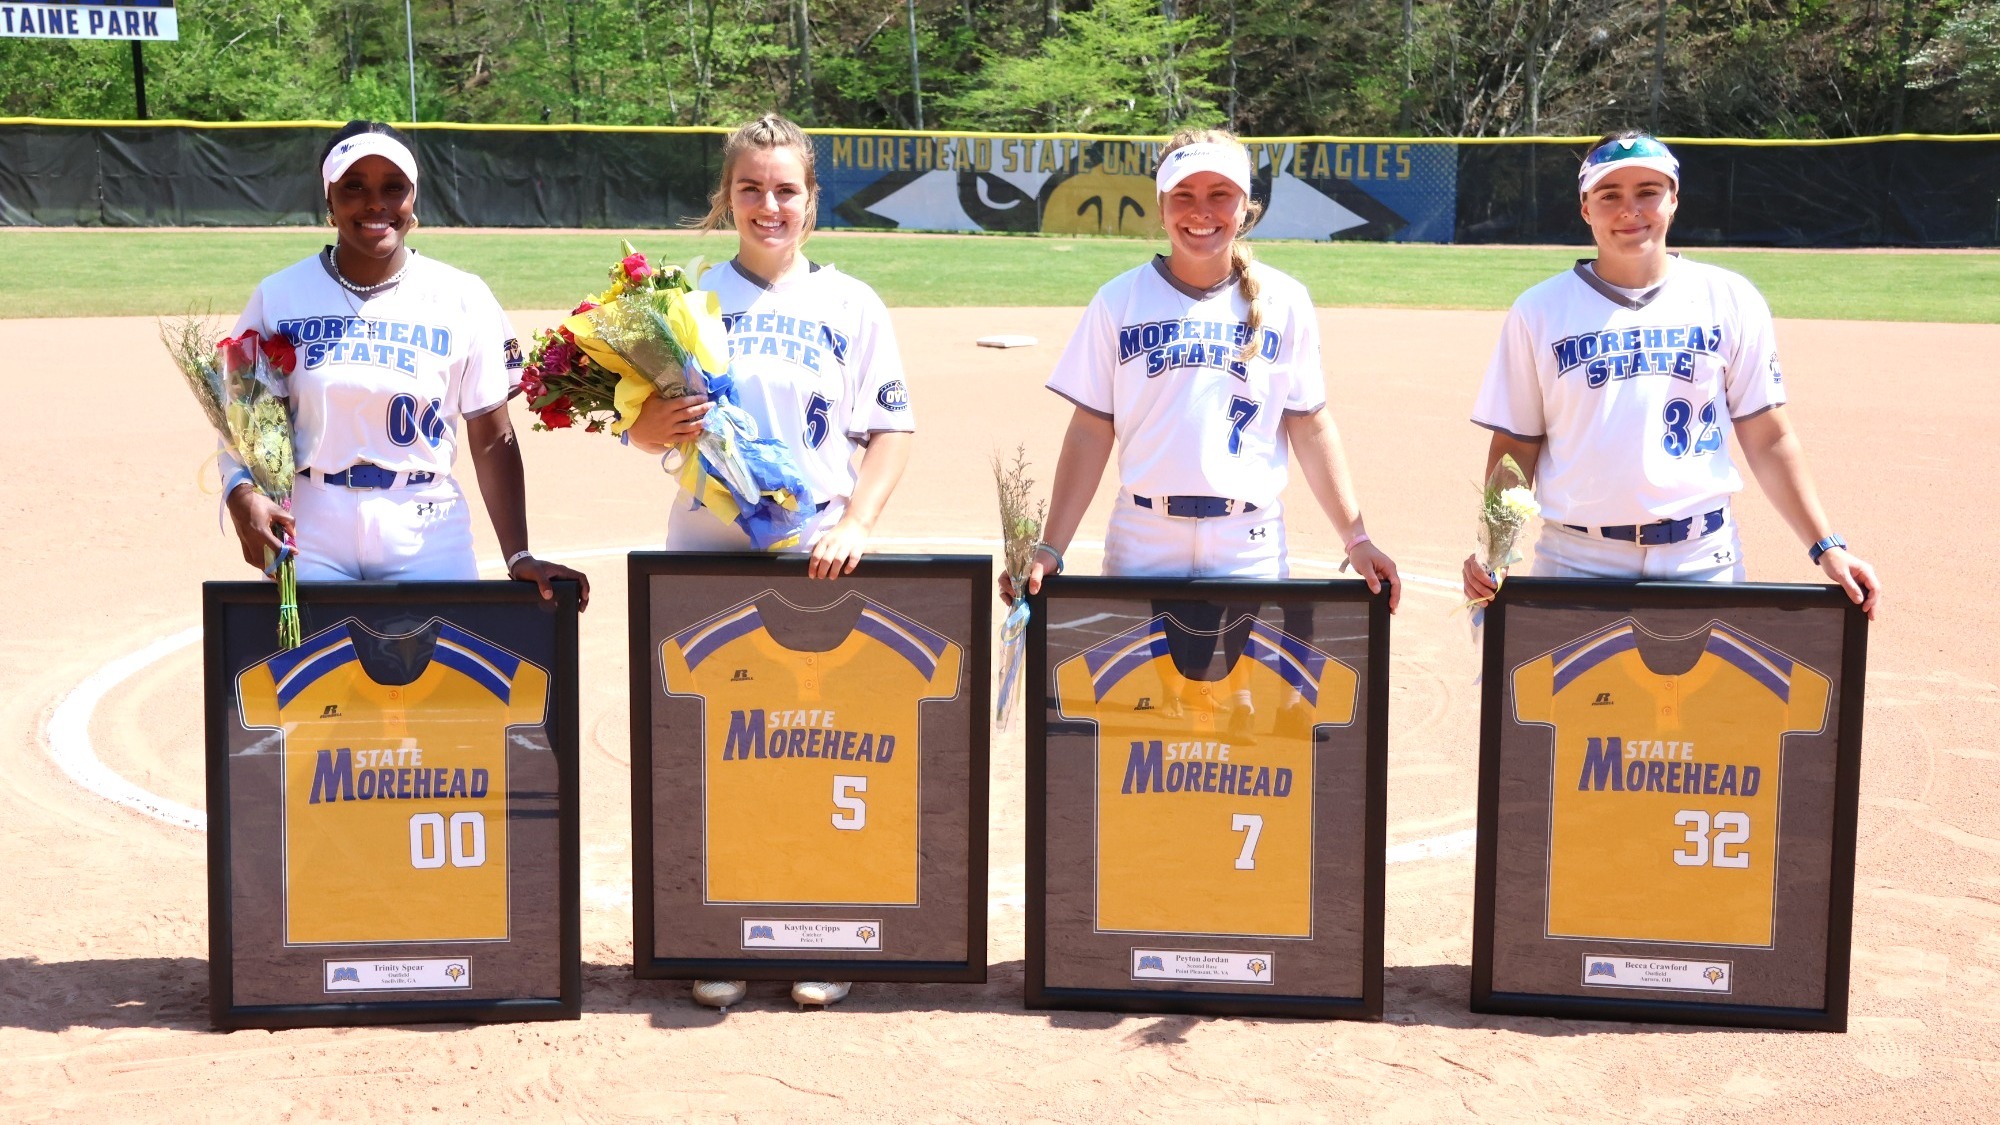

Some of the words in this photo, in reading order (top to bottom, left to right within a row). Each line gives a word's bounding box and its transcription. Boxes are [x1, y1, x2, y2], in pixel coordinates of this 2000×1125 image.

[89, 10, 159, 37] PARK
[832, 136, 992, 172] MOREHEAD
[1002, 138, 1093, 174] STATE
[1102, 140, 1287, 177] UNITY
[1293, 143, 1412, 180] EAGLES
[305, 342, 418, 379] STATE
[1586, 350, 1694, 389] STATE
[803, 391, 835, 451] 5
[1226, 395, 1262, 458] 7
[1661, 397, 1723, 460] 32
[723, 709, 895, 763] MOREHEAD
[768, 709, 835, 728] STATE
[354, 748, 422, 768] STATE
[1121, 740, 1293, 797] MOREHEAD
[1165, 741, 1231, 762] STATE
[1578, 736, 1761, 796] MOREHEAD
[1624, 740, 1694, 760] STATE
[309, 748, 489, 804] MOREHEAD
[831, 775, 868, 831] 5
[409, 811, 487, 869] 00
[1231, 813, 1264, 870] 7
[1673, 809, 1750, 869] 32
[784, 924, 813, 933] Kaytlyn
[815, 924, 840, 933] Cripps
[373, 964, 400, 972] Trinity
[402, 964, 424, 972] Spear
[1176, 955, 1201, 964] Peyton
[1625, 961, 1648, 969] Becca
[1649, 962, 1688, 971] Crawford
